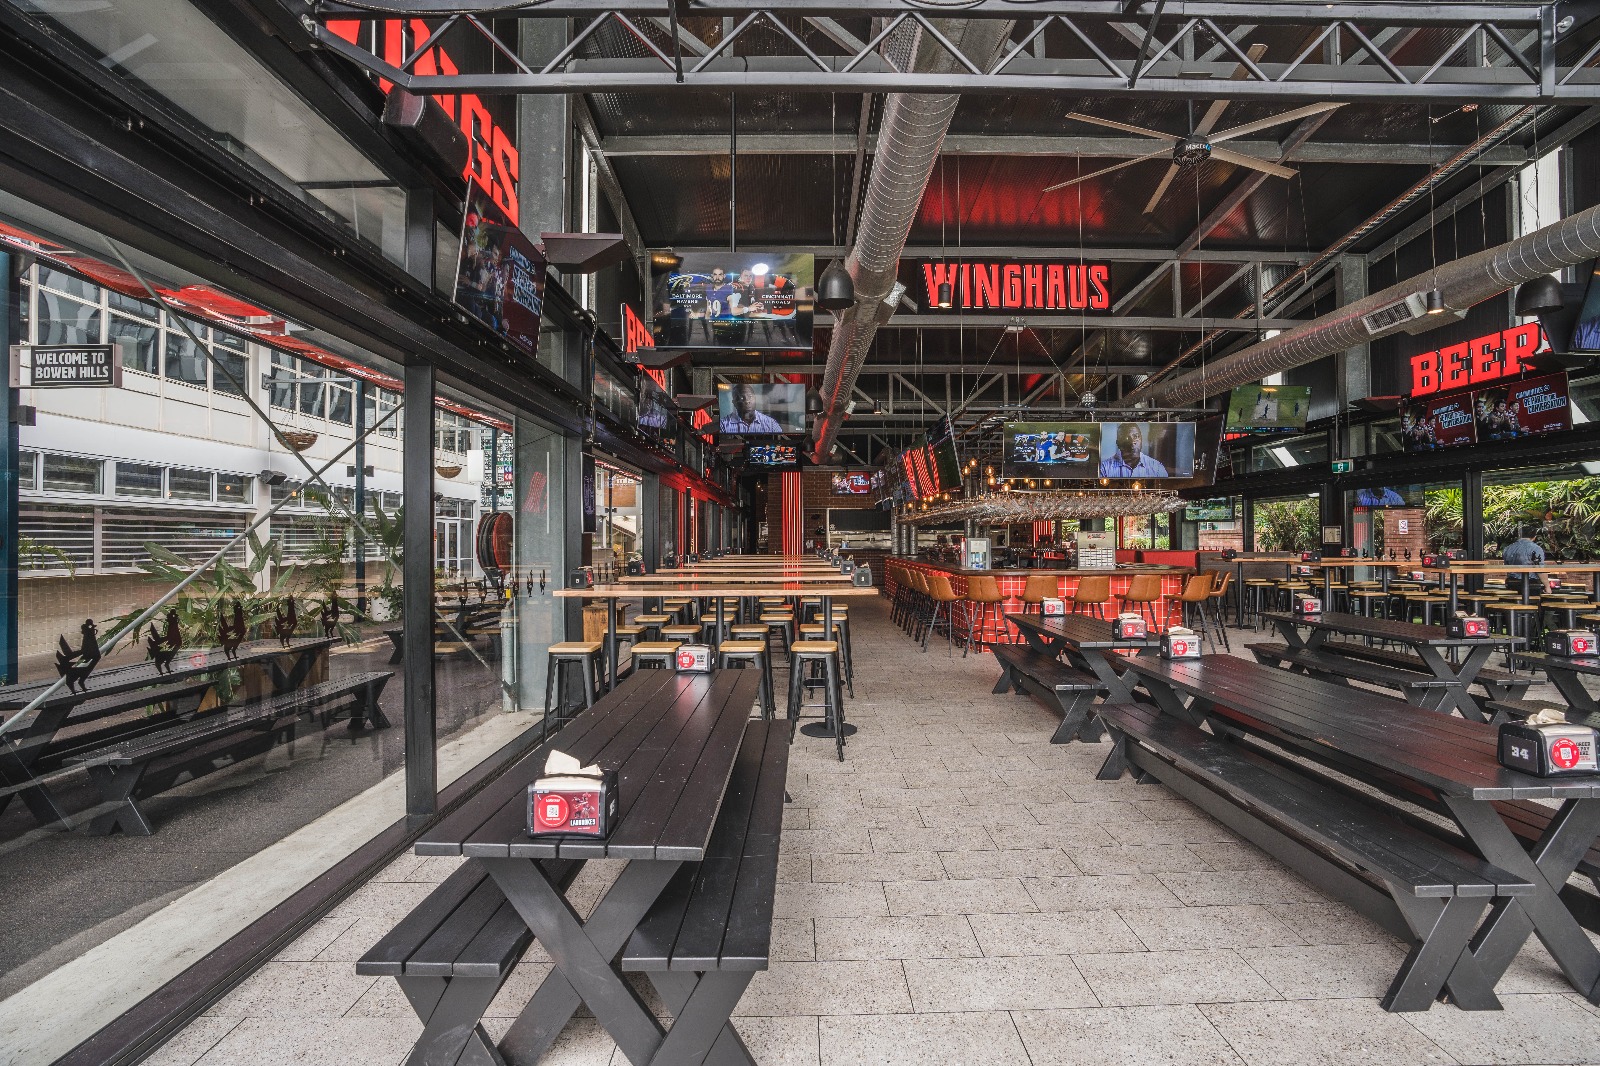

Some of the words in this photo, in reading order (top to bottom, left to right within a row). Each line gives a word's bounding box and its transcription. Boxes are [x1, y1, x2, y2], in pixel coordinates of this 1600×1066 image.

[922, 263, 1110, 309] WINGHAUS
[35, 352, 88, 365] WELCOME
[91, 352, 105, 364] TO
[35, 366, 77, 379] BOWEN
[79, 366, 109, 378] HILLS
[1410, 321, 1552, 398] BEER
